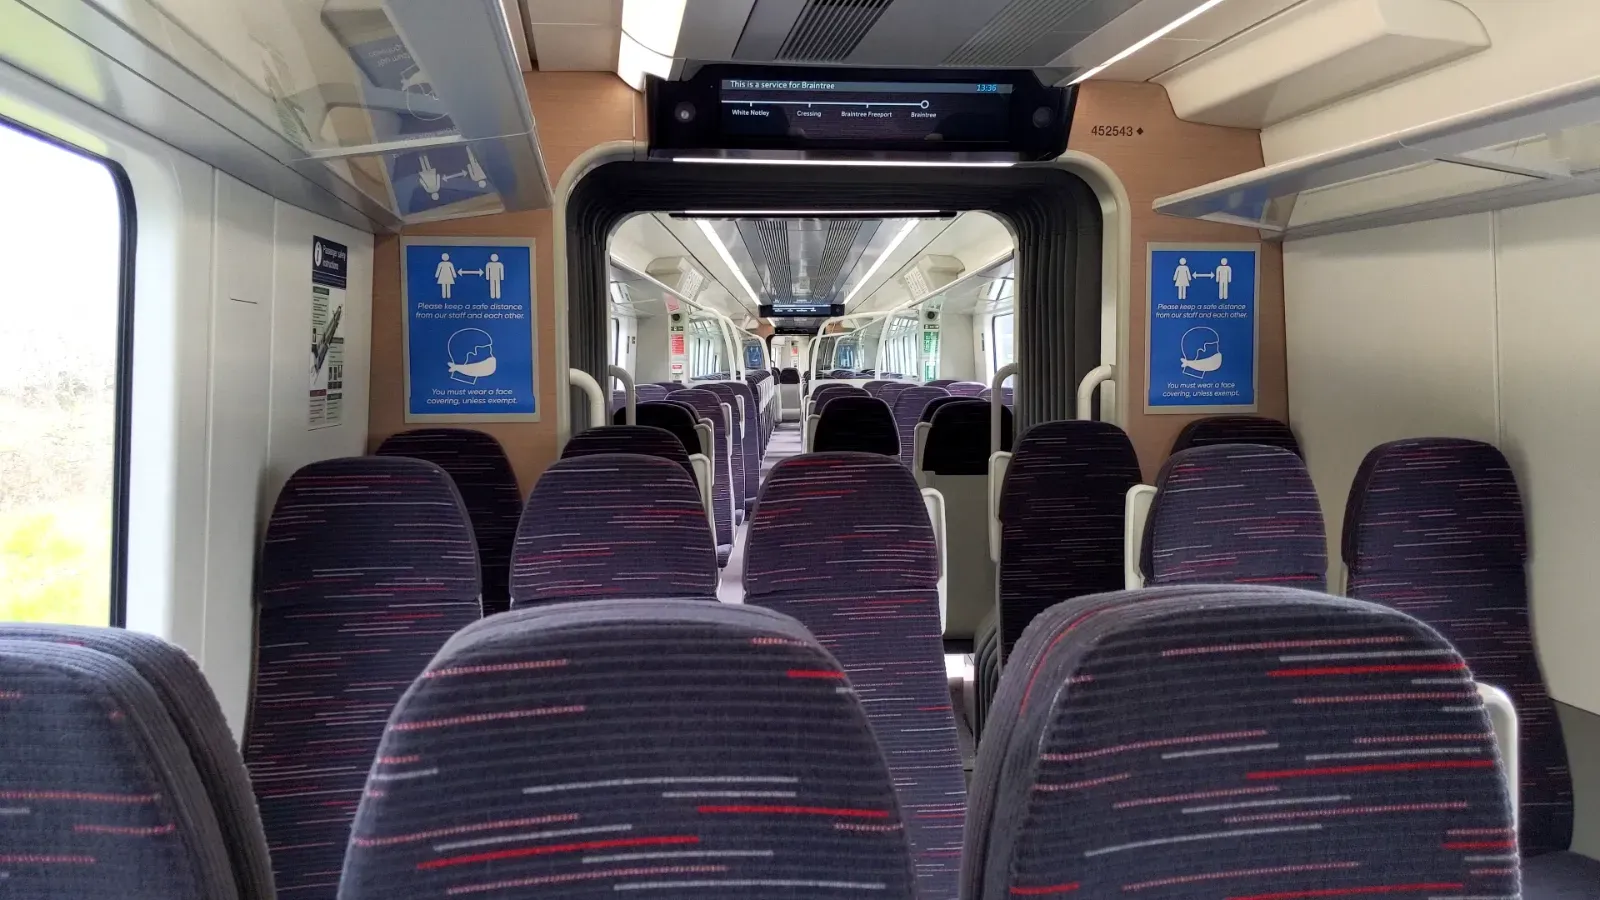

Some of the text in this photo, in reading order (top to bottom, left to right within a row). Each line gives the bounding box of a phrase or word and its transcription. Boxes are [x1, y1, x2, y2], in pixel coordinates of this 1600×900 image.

[730, 80, 746, 88] This
[789, 81, 800, 89] for
[1091, 125, 1133, 137] 452543
[417, 302, 444, 310] Please
[444, 302, 464, 311] keep
[426, 397, 460, 406] covering,
[487, 397, 518, 406] exempt.
